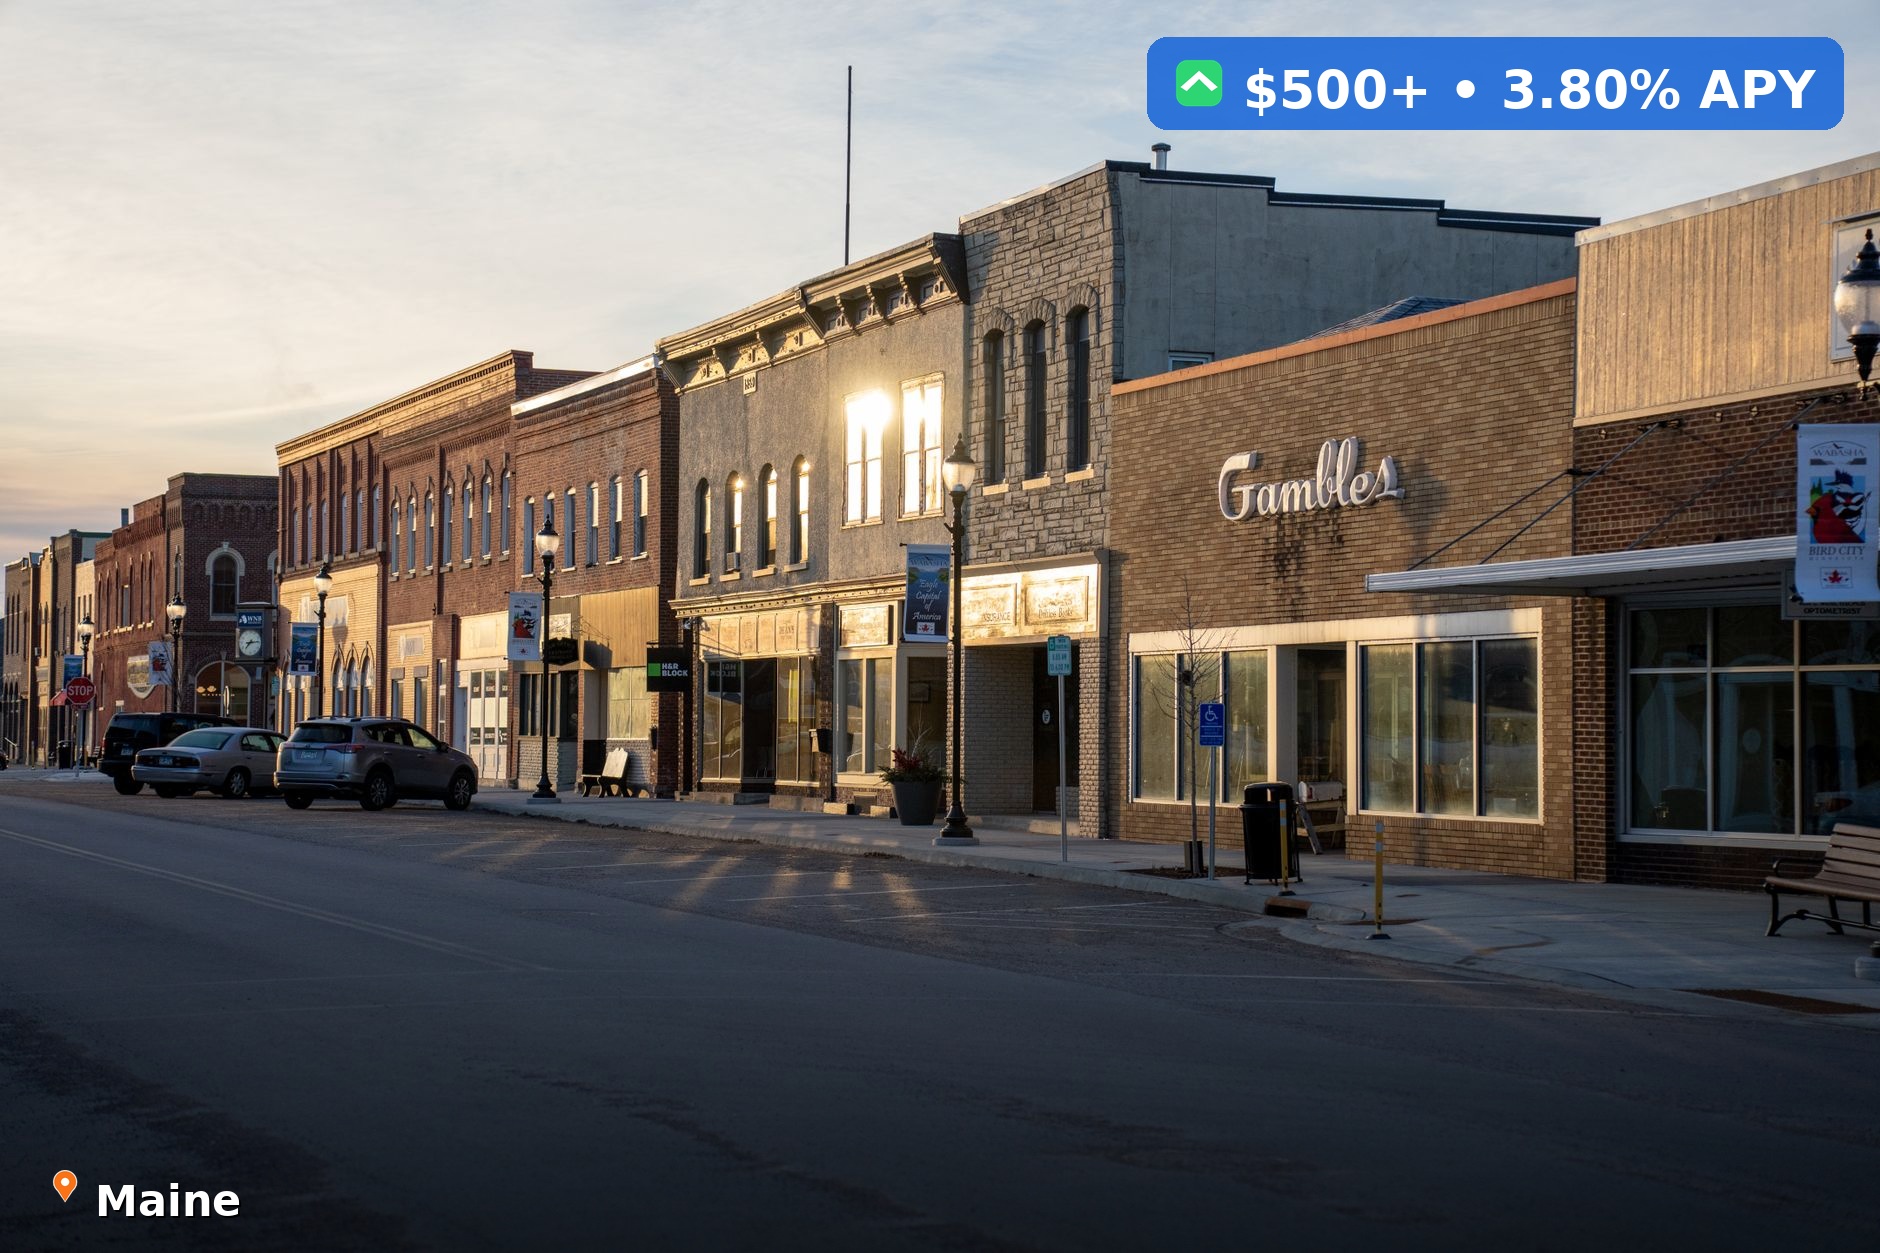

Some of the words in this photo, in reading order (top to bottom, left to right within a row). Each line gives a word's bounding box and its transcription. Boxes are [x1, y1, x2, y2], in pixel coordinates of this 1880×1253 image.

[1218, 436, 1406, 521] Gambles
[1808, 546, 1836, 556] BIRD
[1838, 546, 1865, 555] CITY
[920, 579, 938, 592] Eagle
[915, 591, 942, 603] Capital
[924, 601, 933, 612] of
[912, 612, 942, 621] America
[67, 685, 94, 696] STOP
